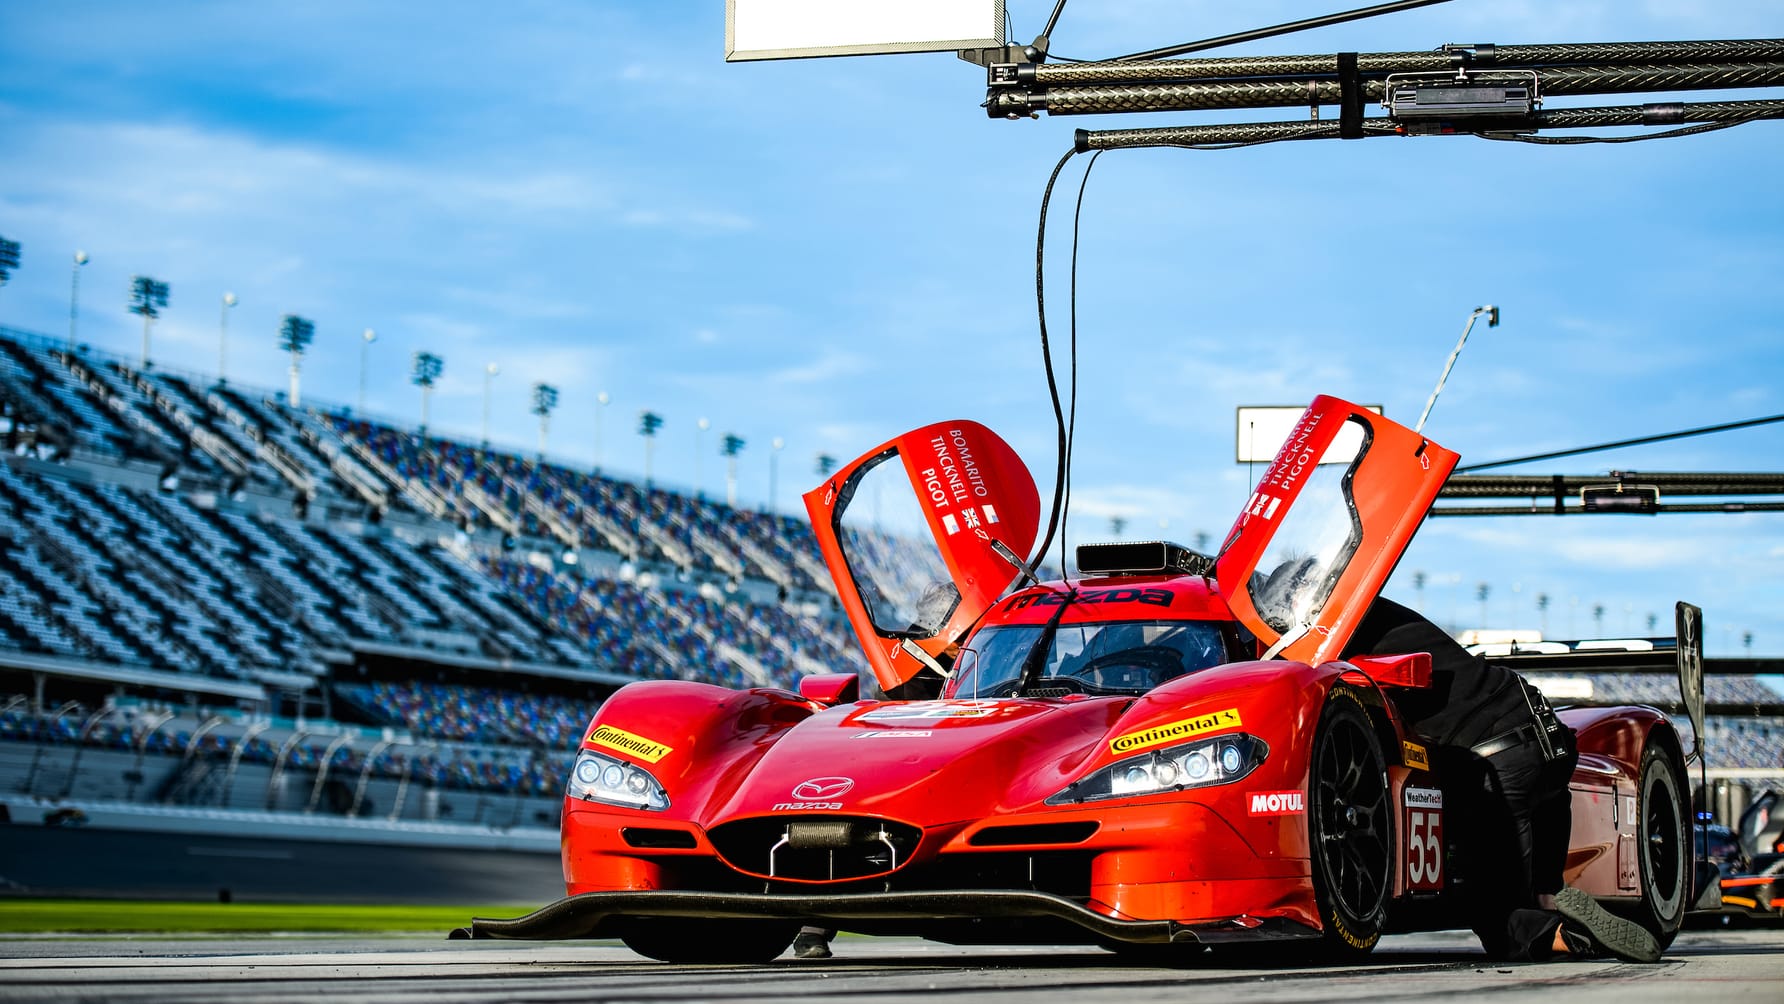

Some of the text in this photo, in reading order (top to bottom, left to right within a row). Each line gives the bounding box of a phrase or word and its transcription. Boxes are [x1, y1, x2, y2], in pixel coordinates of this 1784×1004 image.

[930, 435, 968, 503] TINCKNELL
[949, 429, 988, 497] BOMARITO
[1268, 412, 1323, 485] TINCKNELL
[1281, 444, 1314, 490] PIGOT
[921, 467, 950, 508] PIGOT
[590, 727, 657, 755] Continental
[1112, 715, 1220, 752] Continental
[1251, 793, 1304, 813] MOTUL
[1406, 791, 1441, 804] WeatherTech
[1409, 812, 1441, 884] 55
